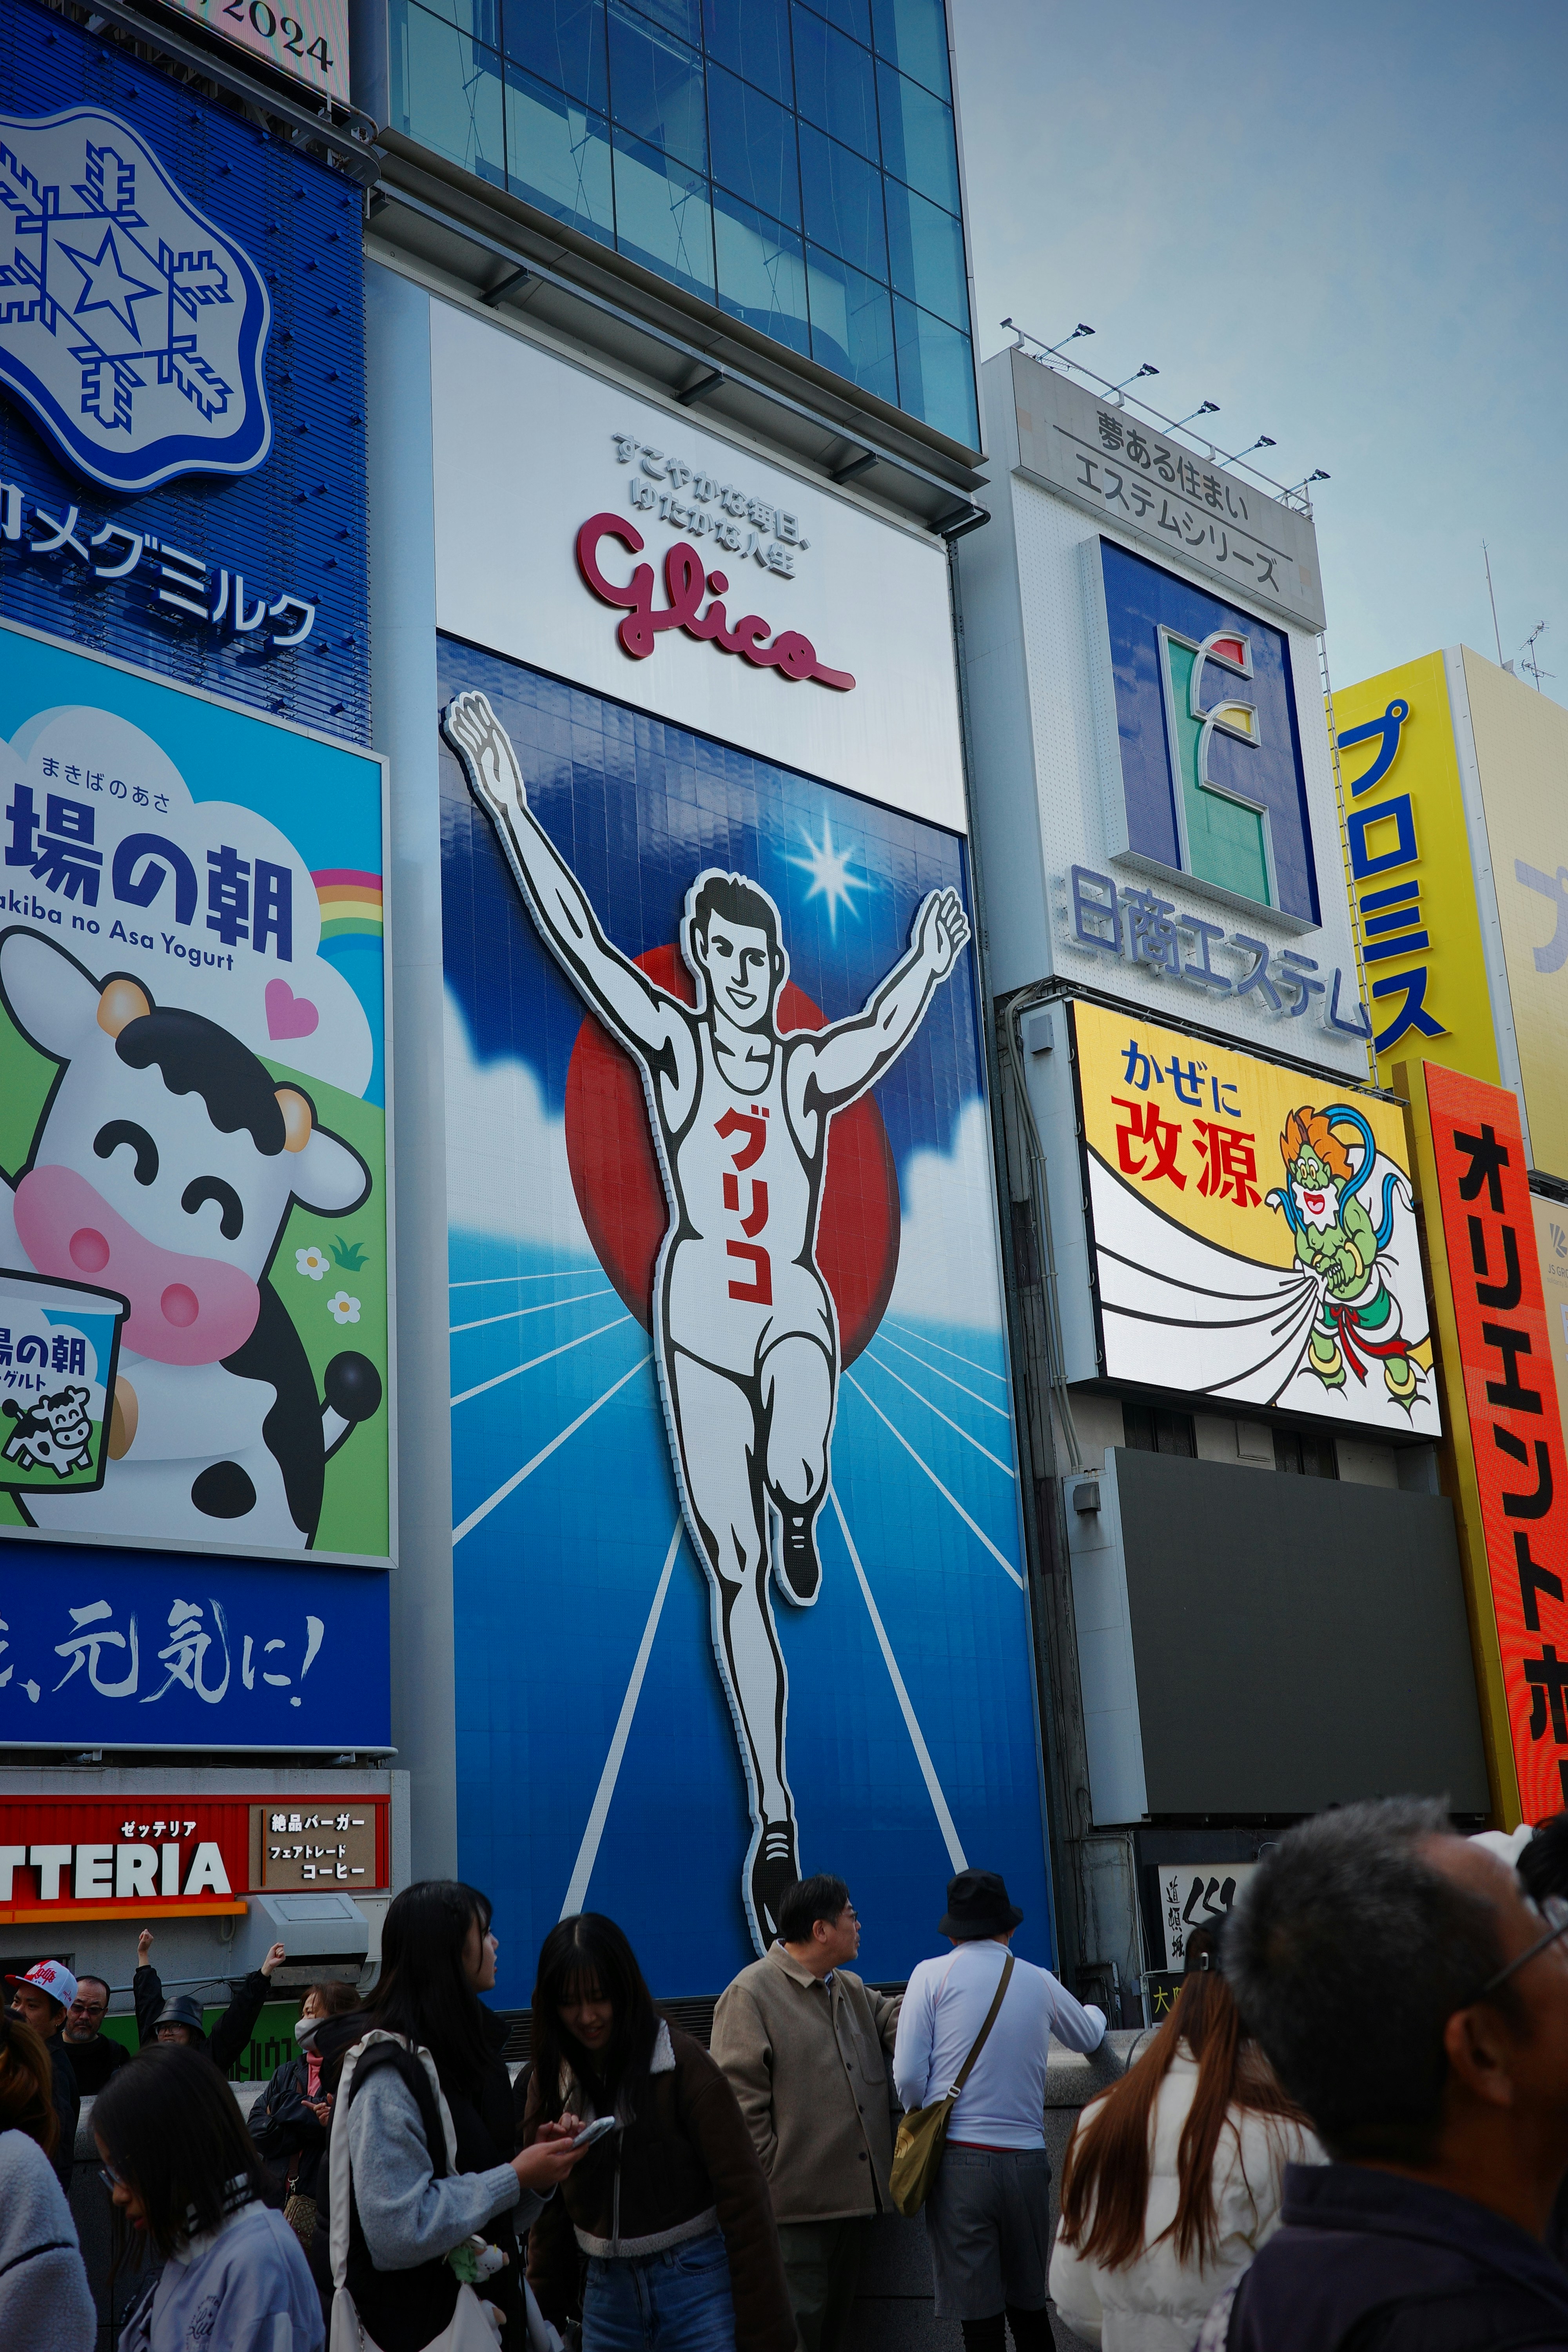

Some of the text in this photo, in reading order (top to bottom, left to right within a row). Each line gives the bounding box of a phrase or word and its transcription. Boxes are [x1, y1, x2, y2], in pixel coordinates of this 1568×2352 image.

[612, 432, 811, 550] すこやかな毎日、
[1097, 410, 1248, 520] 夢ある住まい
[632, 477, 796, 579] ゆたかな人生
[1076, 453, 1279, 592] エステムシリーズ
[577, 512, 856, 691] Glico
[42, 757, 170, 814] まきばのあさ
[5, 783, 292, 963] 場の朝
[1337, 698, 1449, 1056] プロミス
[72, 915, 100, 934] no
[109, 920, 154, 950] Asa
[161, 932, 234, 971] Yogurt
[1065, 864, 1373, 1040] 日商エステム
[1121, 1039, 1241, 1118] かぜに
[1111, 1095, 1262, 1209] 改源
[713, 1104, 773, 1306] グリコ
[1548, 1264, 1555, 1274] JS
[0, 1370, 46, 1392] グルト
[121, 1820, 196, 1837] ゼッテリア
[269, 1844, 346, 1860] フェアトレード
[271, 1813, 365, 1832] 絶品バーガー
[302, 1862, 365, 1880] コーヒー
